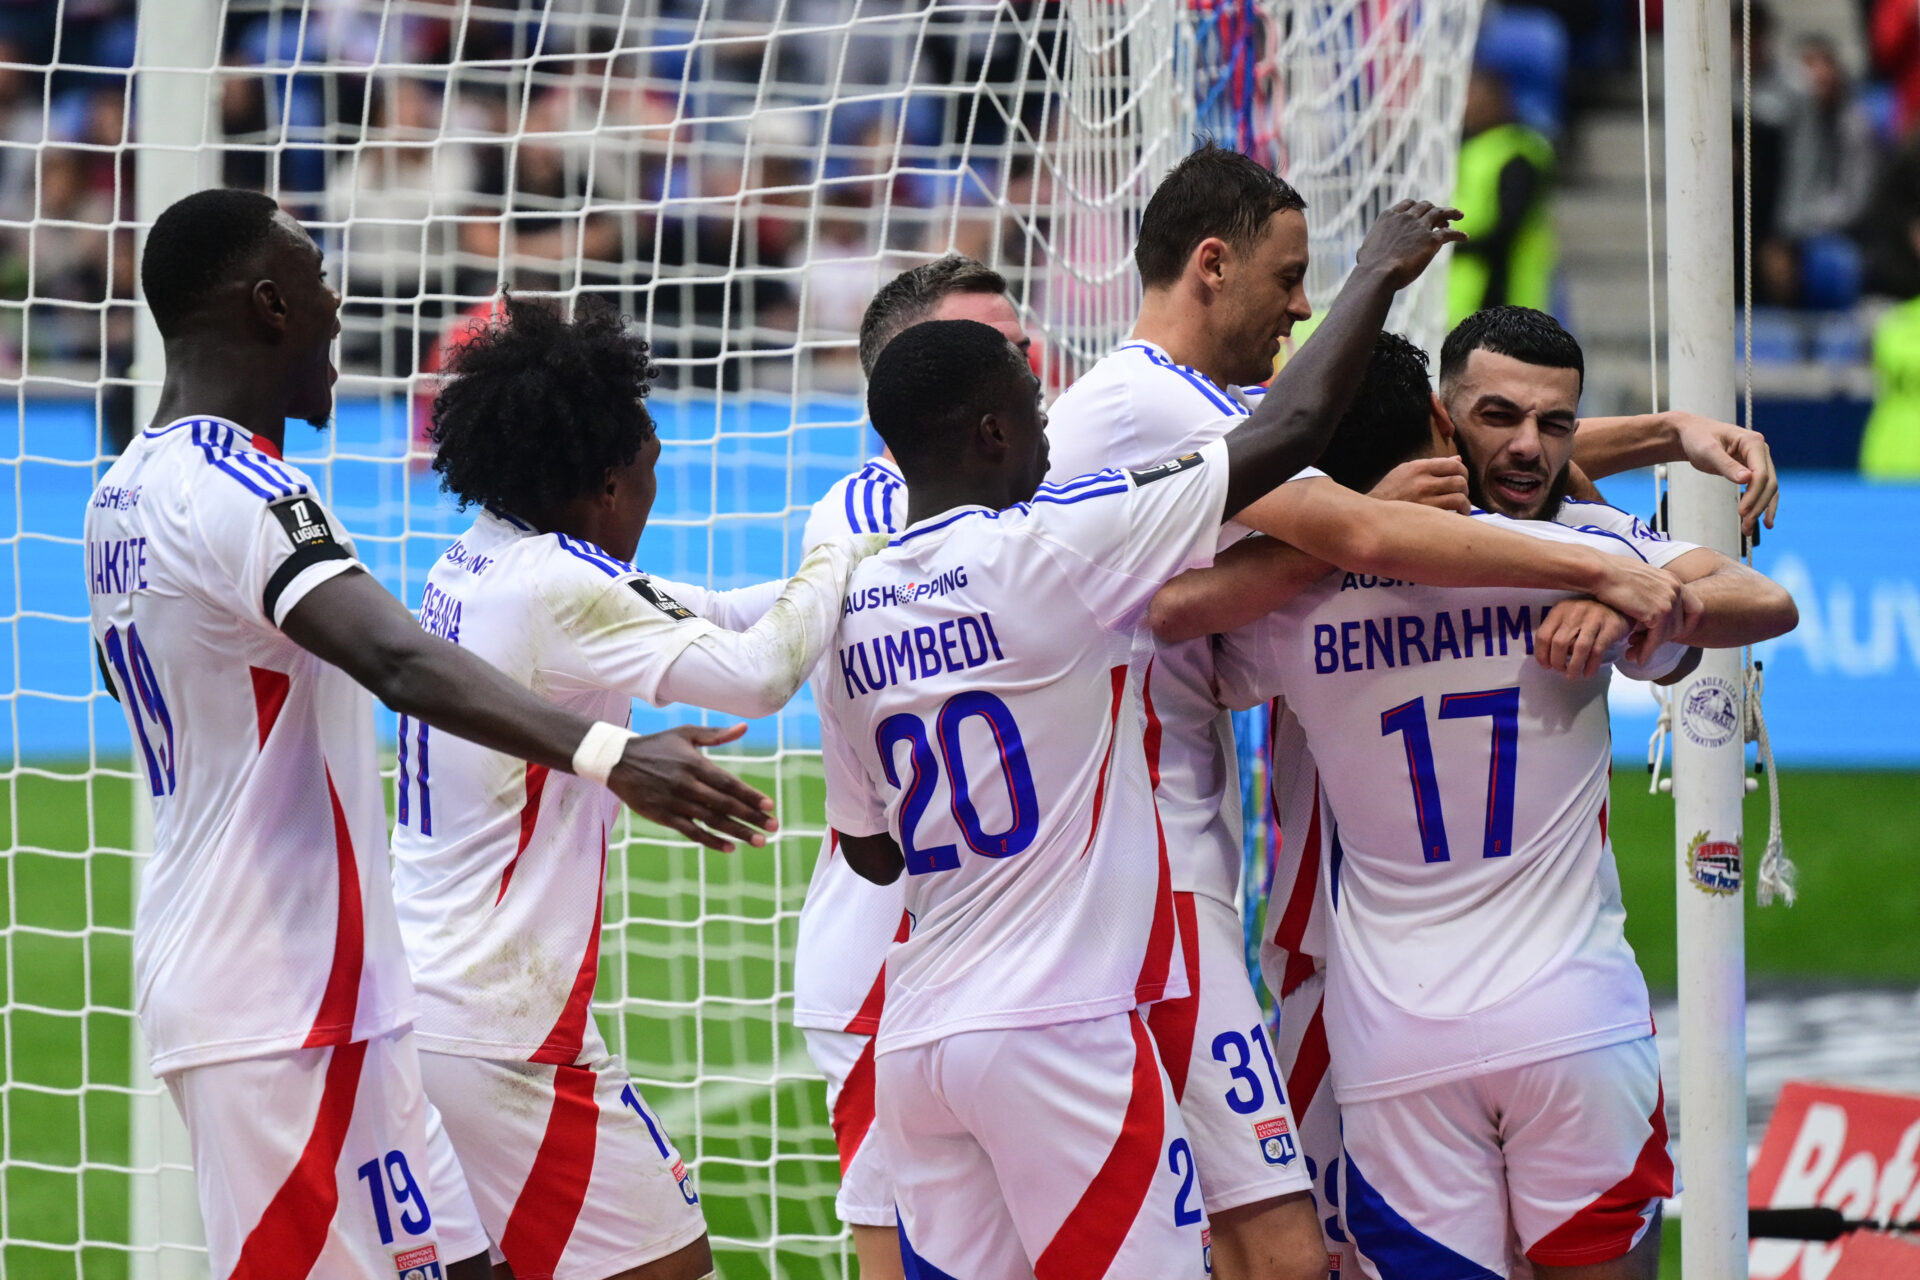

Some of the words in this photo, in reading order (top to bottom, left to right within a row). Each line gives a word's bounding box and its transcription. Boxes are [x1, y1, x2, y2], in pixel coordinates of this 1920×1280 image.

[844, 566, 968, 618] AUSHOPPING
[839, 611, 1005, 699] KUMBEDI
[104, 621, 176, 797] 19
[875, 690, 1040, 876] 20
[1381, 687, 1520, 864] 17
[1211, 1023, 1286, 1115] 31
[358, 1149, 432, 1245] 19
[1168, 1137, 1203, 1228] 2
